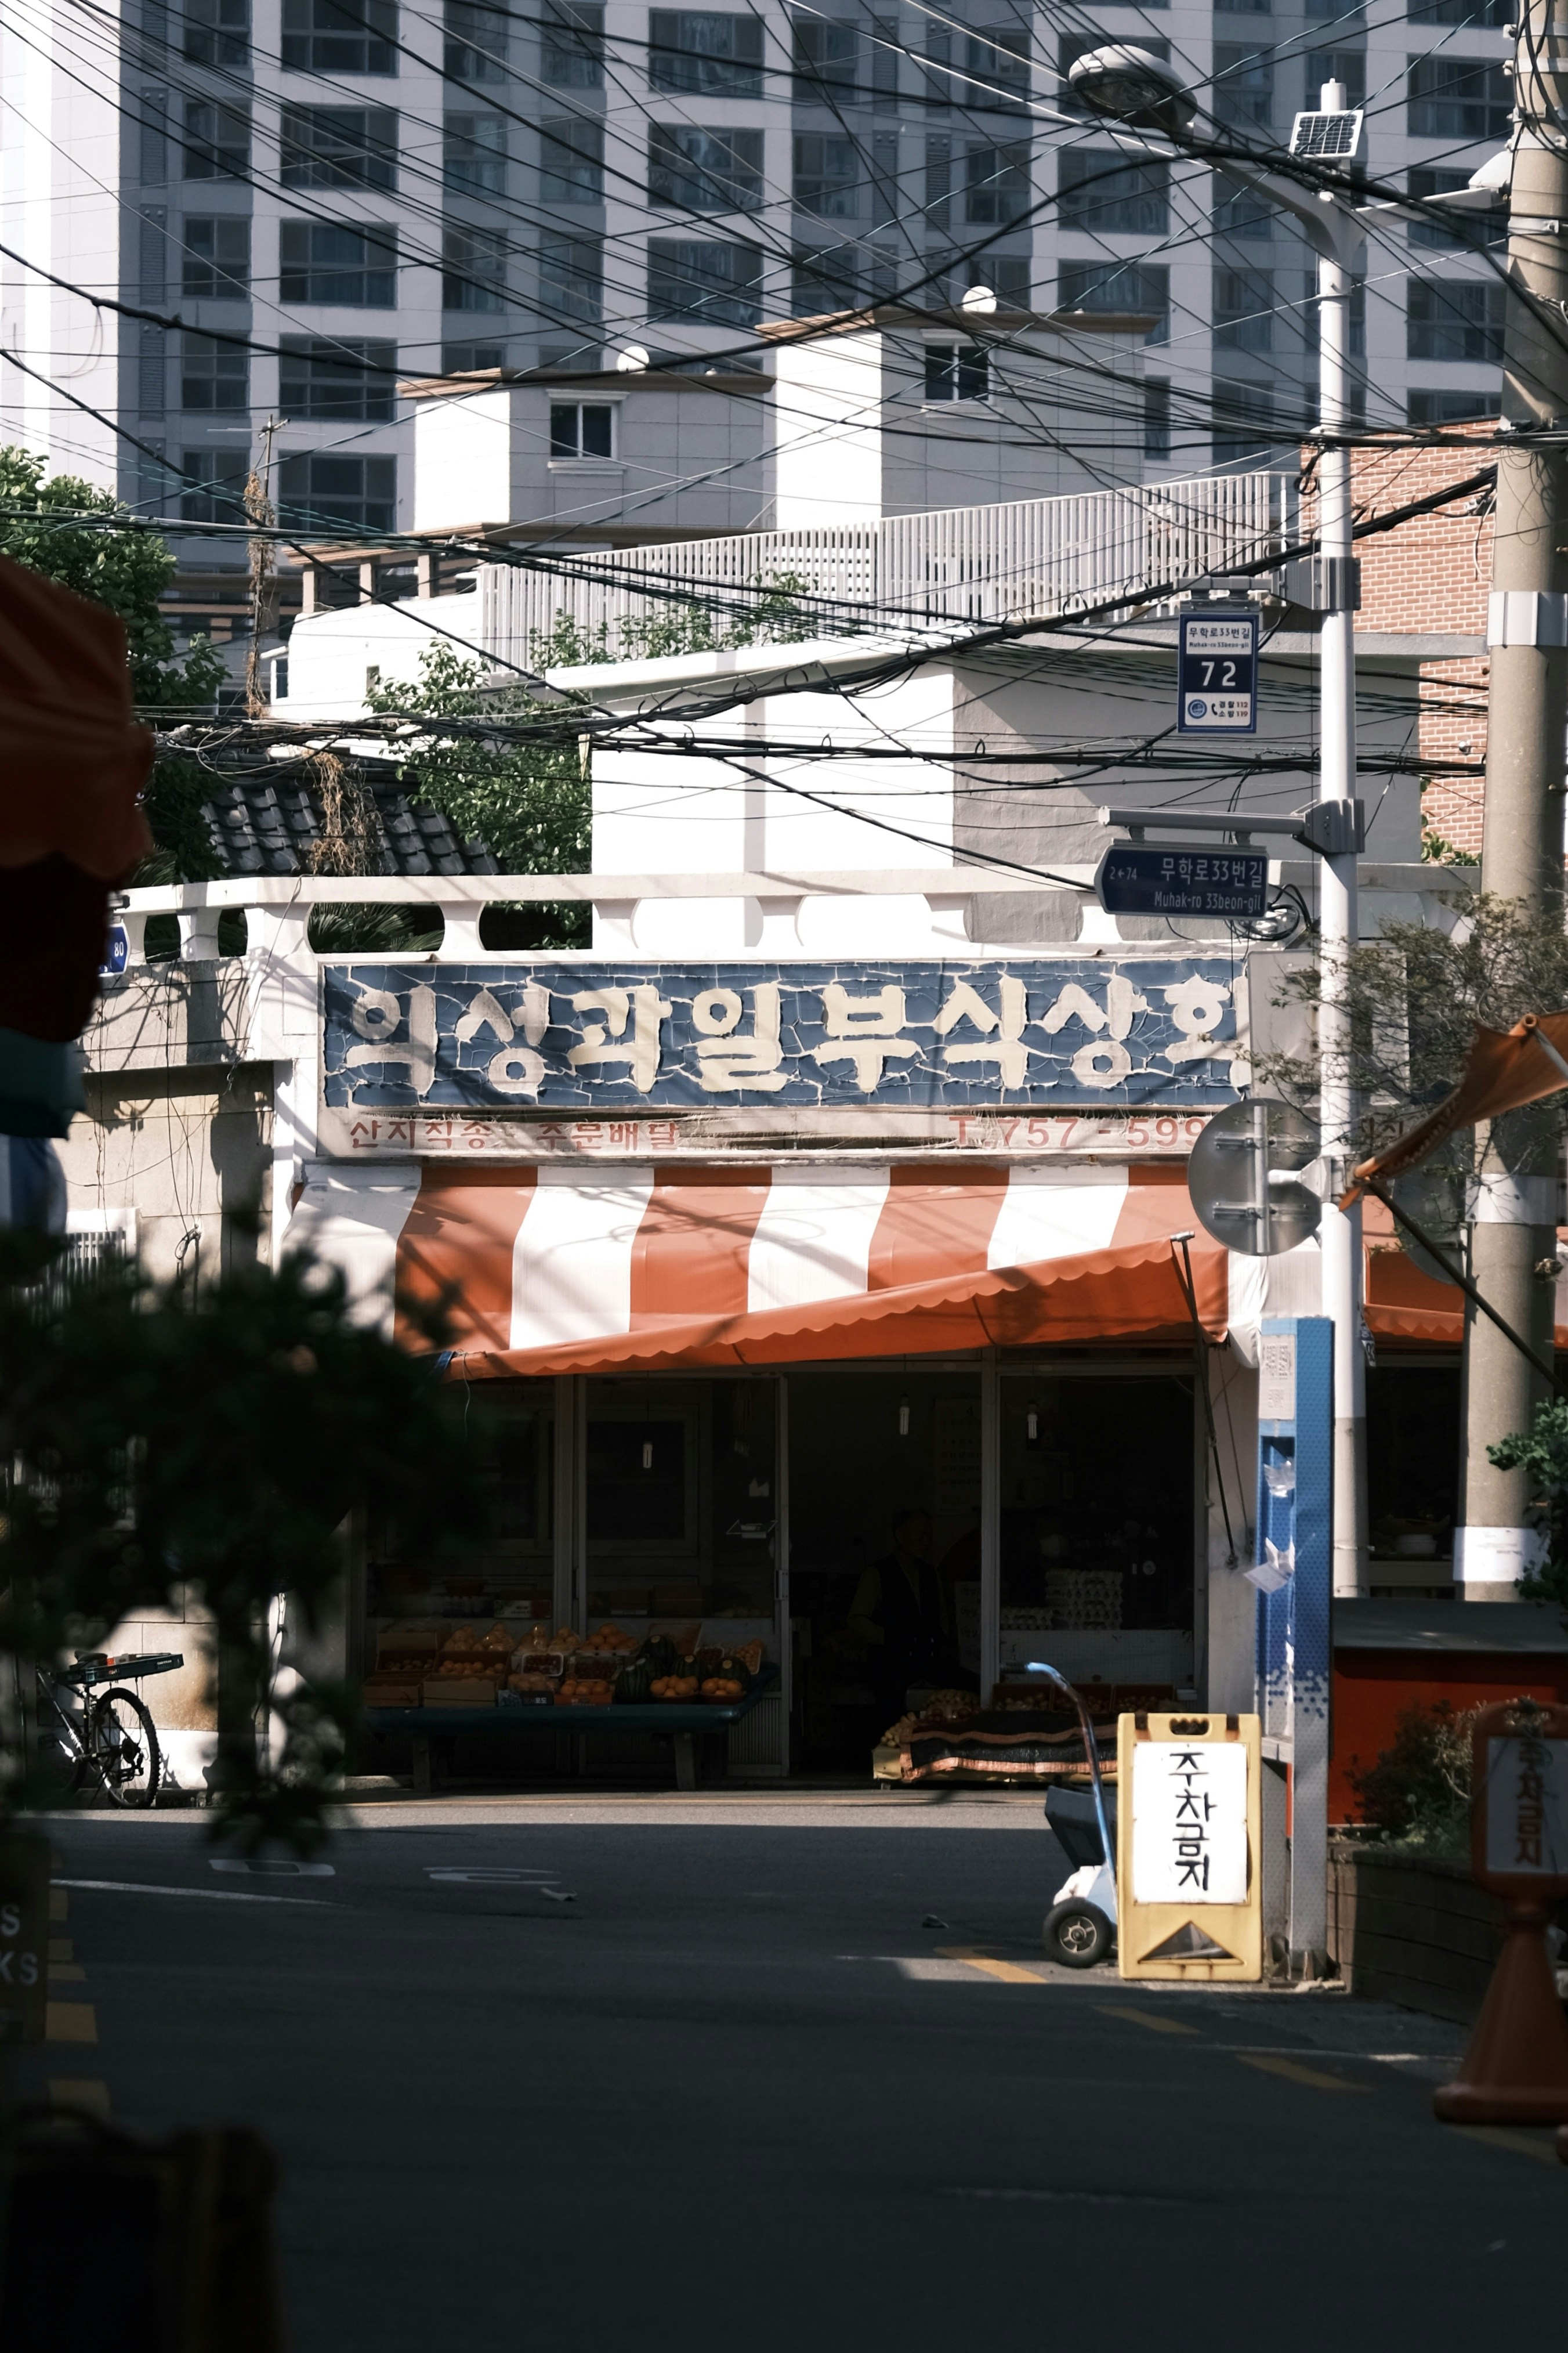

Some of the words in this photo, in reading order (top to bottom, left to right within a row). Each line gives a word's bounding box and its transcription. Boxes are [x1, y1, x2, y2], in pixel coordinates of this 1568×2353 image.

[1189, 627, 1250, 639] 무학로33번길
[1201, 660, 1236, 686] 72
[1161, 857, 1262, 888] 무학로33번길
[1154, 891, 1202, 908] Muhak-ro
[1206, 892, 1261, 913] 33beon-gil
[114, 941, 124, 957] 80
[350, 1119, 493, 1150] 산지직송
[537, 1121, 680, 1150] 주문배달
[1168, 1752, 1218, 1891] 주차금지
